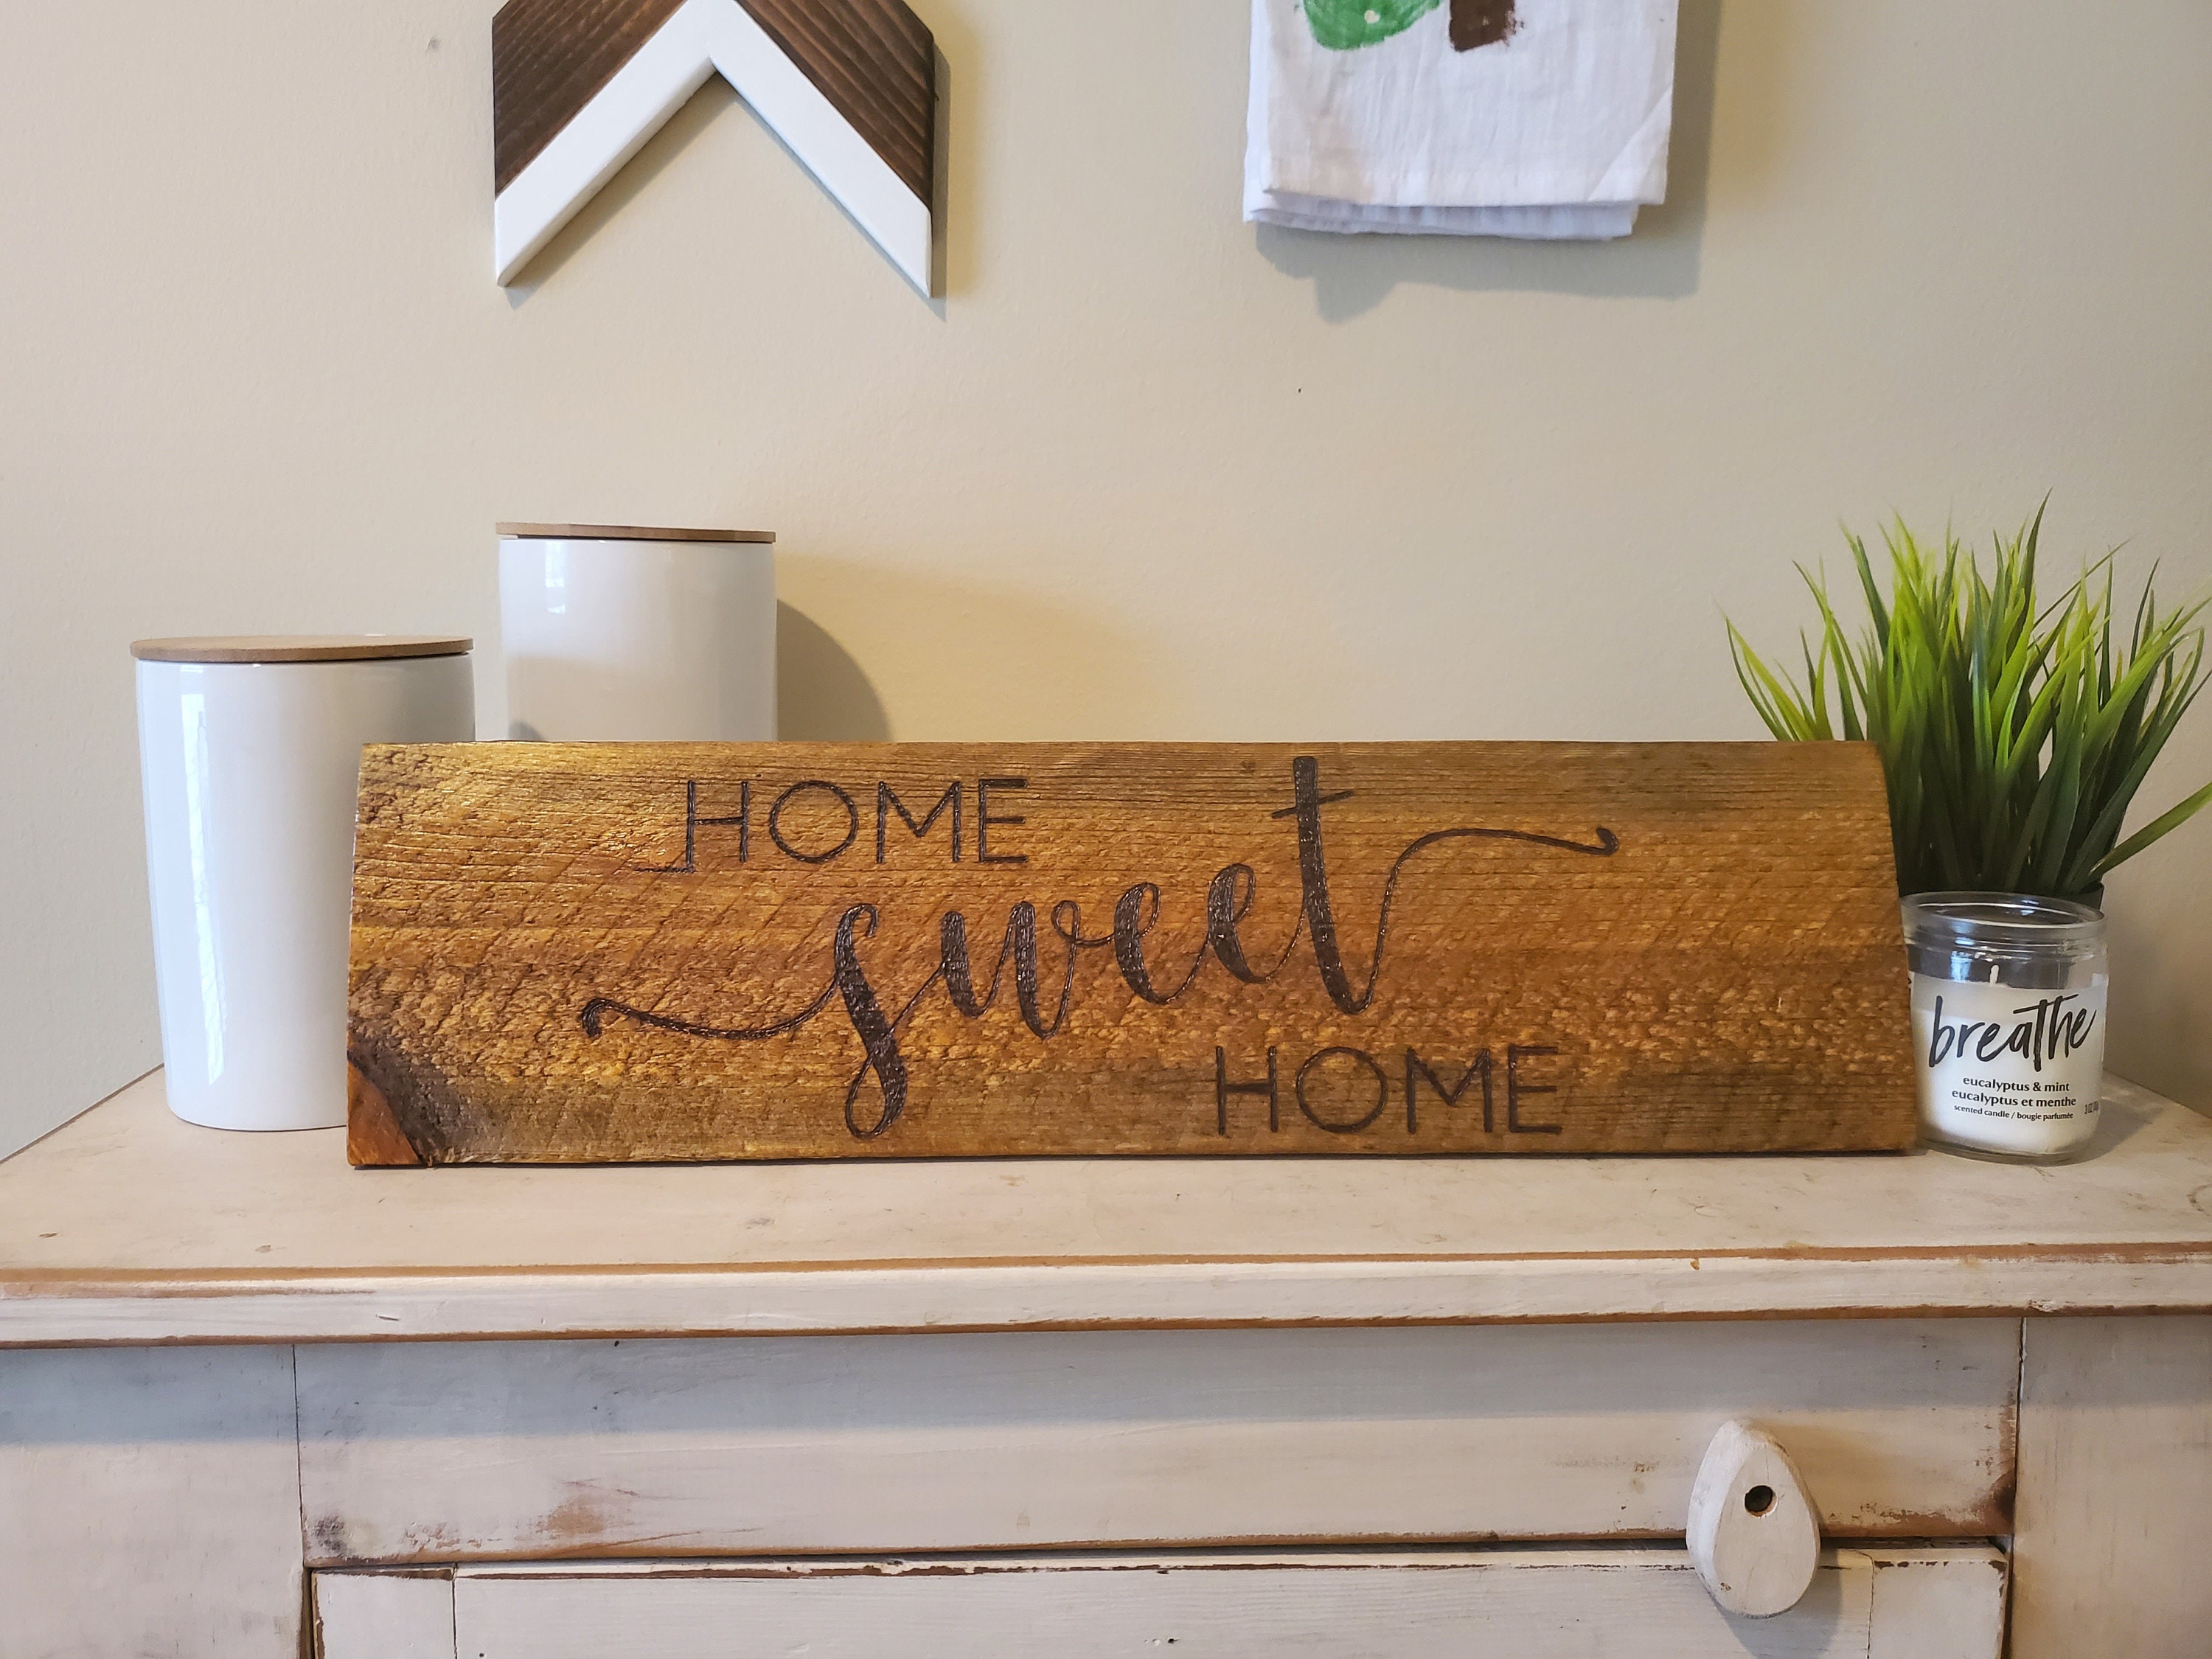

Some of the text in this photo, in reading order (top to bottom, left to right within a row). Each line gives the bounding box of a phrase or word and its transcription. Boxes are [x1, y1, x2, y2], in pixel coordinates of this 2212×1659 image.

[634, 778, 1029, 873] HOME
[580, 755, 1619, 1140] sweet
[1928, 993, 2097, 1072] breathe
[1215, 1045, 1563, 1136] HOME
[1952, 1090, 2018, 1107] eucalyptus
[2021, 1097, 2034, 1107] et
[2036, 1096, 2076, 1107] menthe
[1954, 1105, 1983, 1115] scented
[1984, 1109, 2010, 1118] candle
[2017, 1112, 2042, 1121] bougie
[1963, 1077, 2070, 1093] eucalyptus & mint
